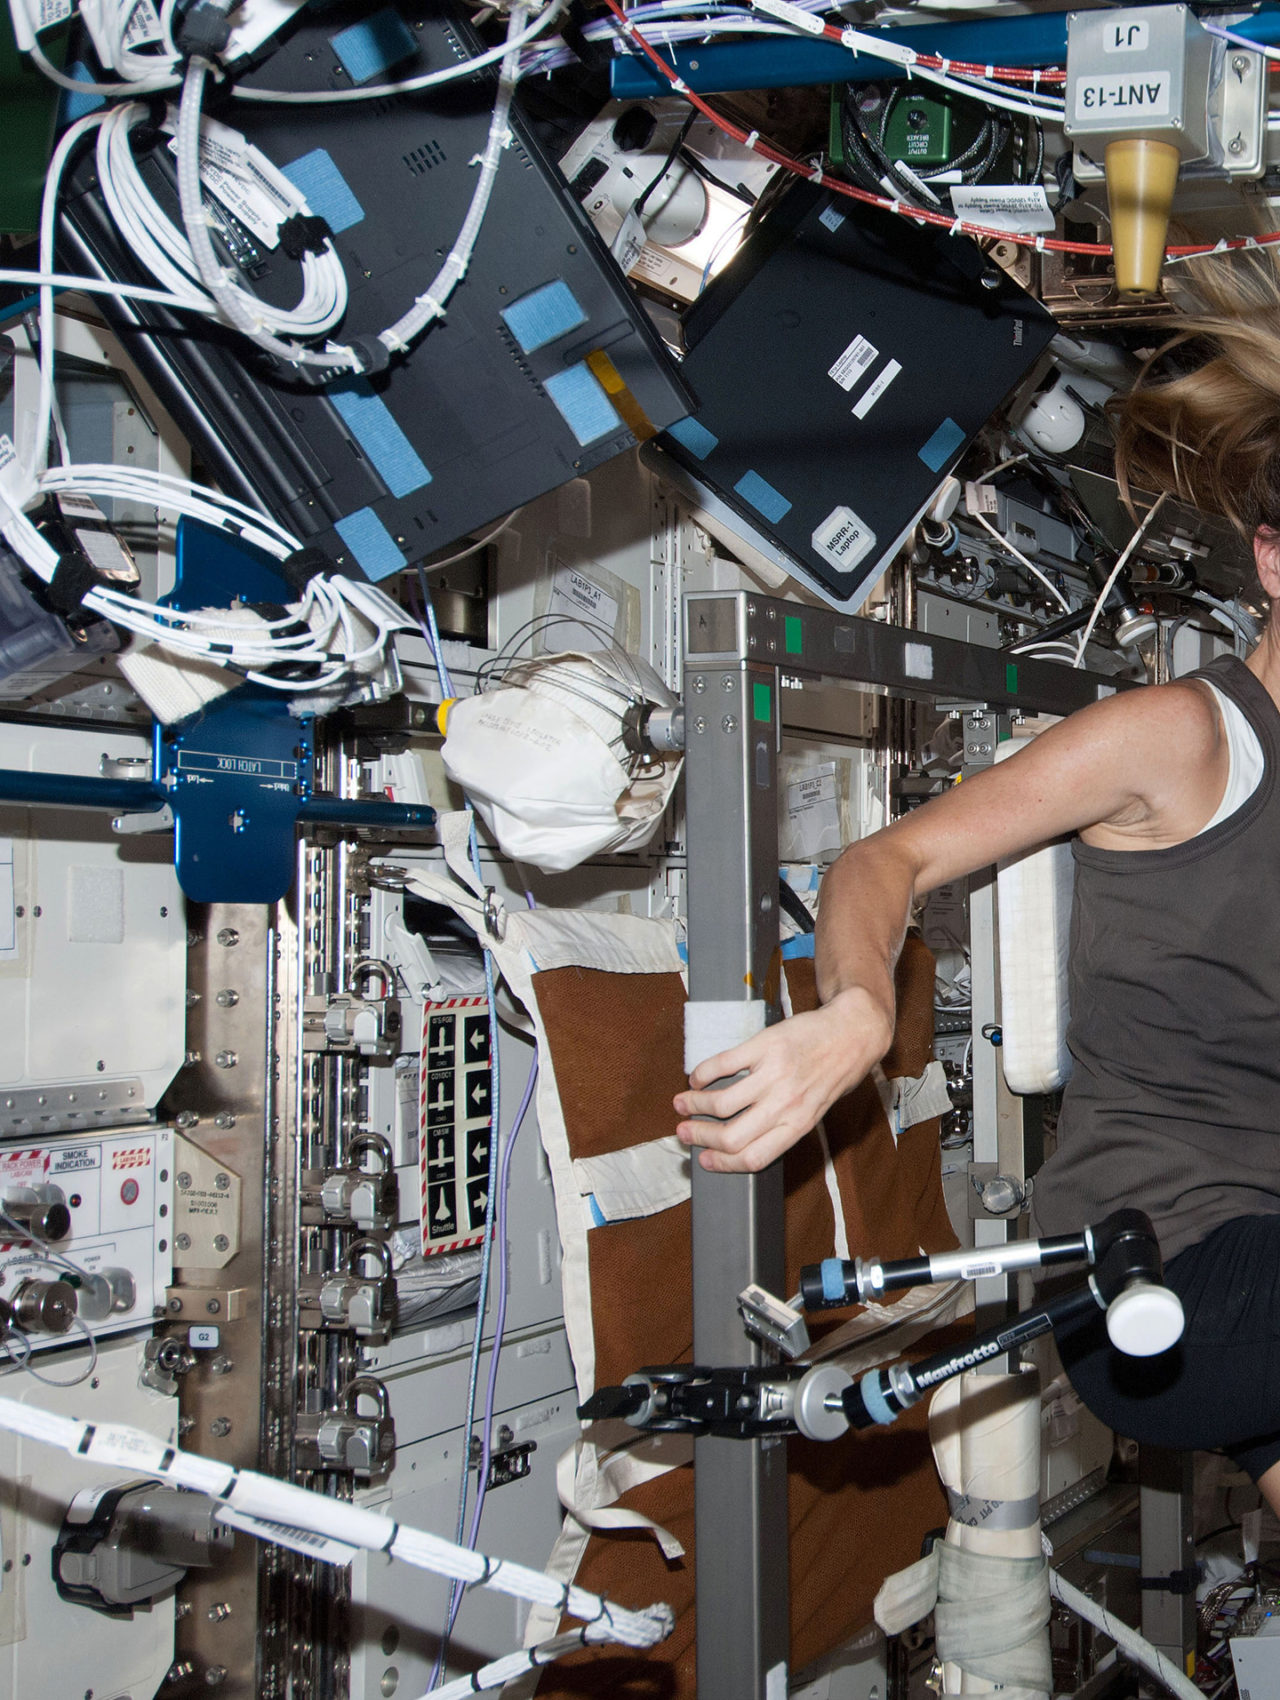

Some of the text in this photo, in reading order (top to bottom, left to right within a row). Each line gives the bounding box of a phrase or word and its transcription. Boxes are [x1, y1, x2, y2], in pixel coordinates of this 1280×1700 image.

[1115, 25, 1140, 46] J1
[1083, 83, 1161, 108] ANT-13
[826, 520, 854, 551] MSRR-1
[835, 529, 860, 556] Laptop
[217, 757, 261, 773] LATCH LOCK
[186, 774, 200, 784] Lock
[20, 1158, 42, 1169] POWER
[62, 1150, 89, 1161] SMOKE
[54, 1158, 96, 1171] INDICATION
[431, 1222, 455, 1234] Shuttle
[198, 1332, 209, 1341] G2
[916, 1341, 1000, 1389] Manfrotto
[979, 1504, 993, 1520] PIT
